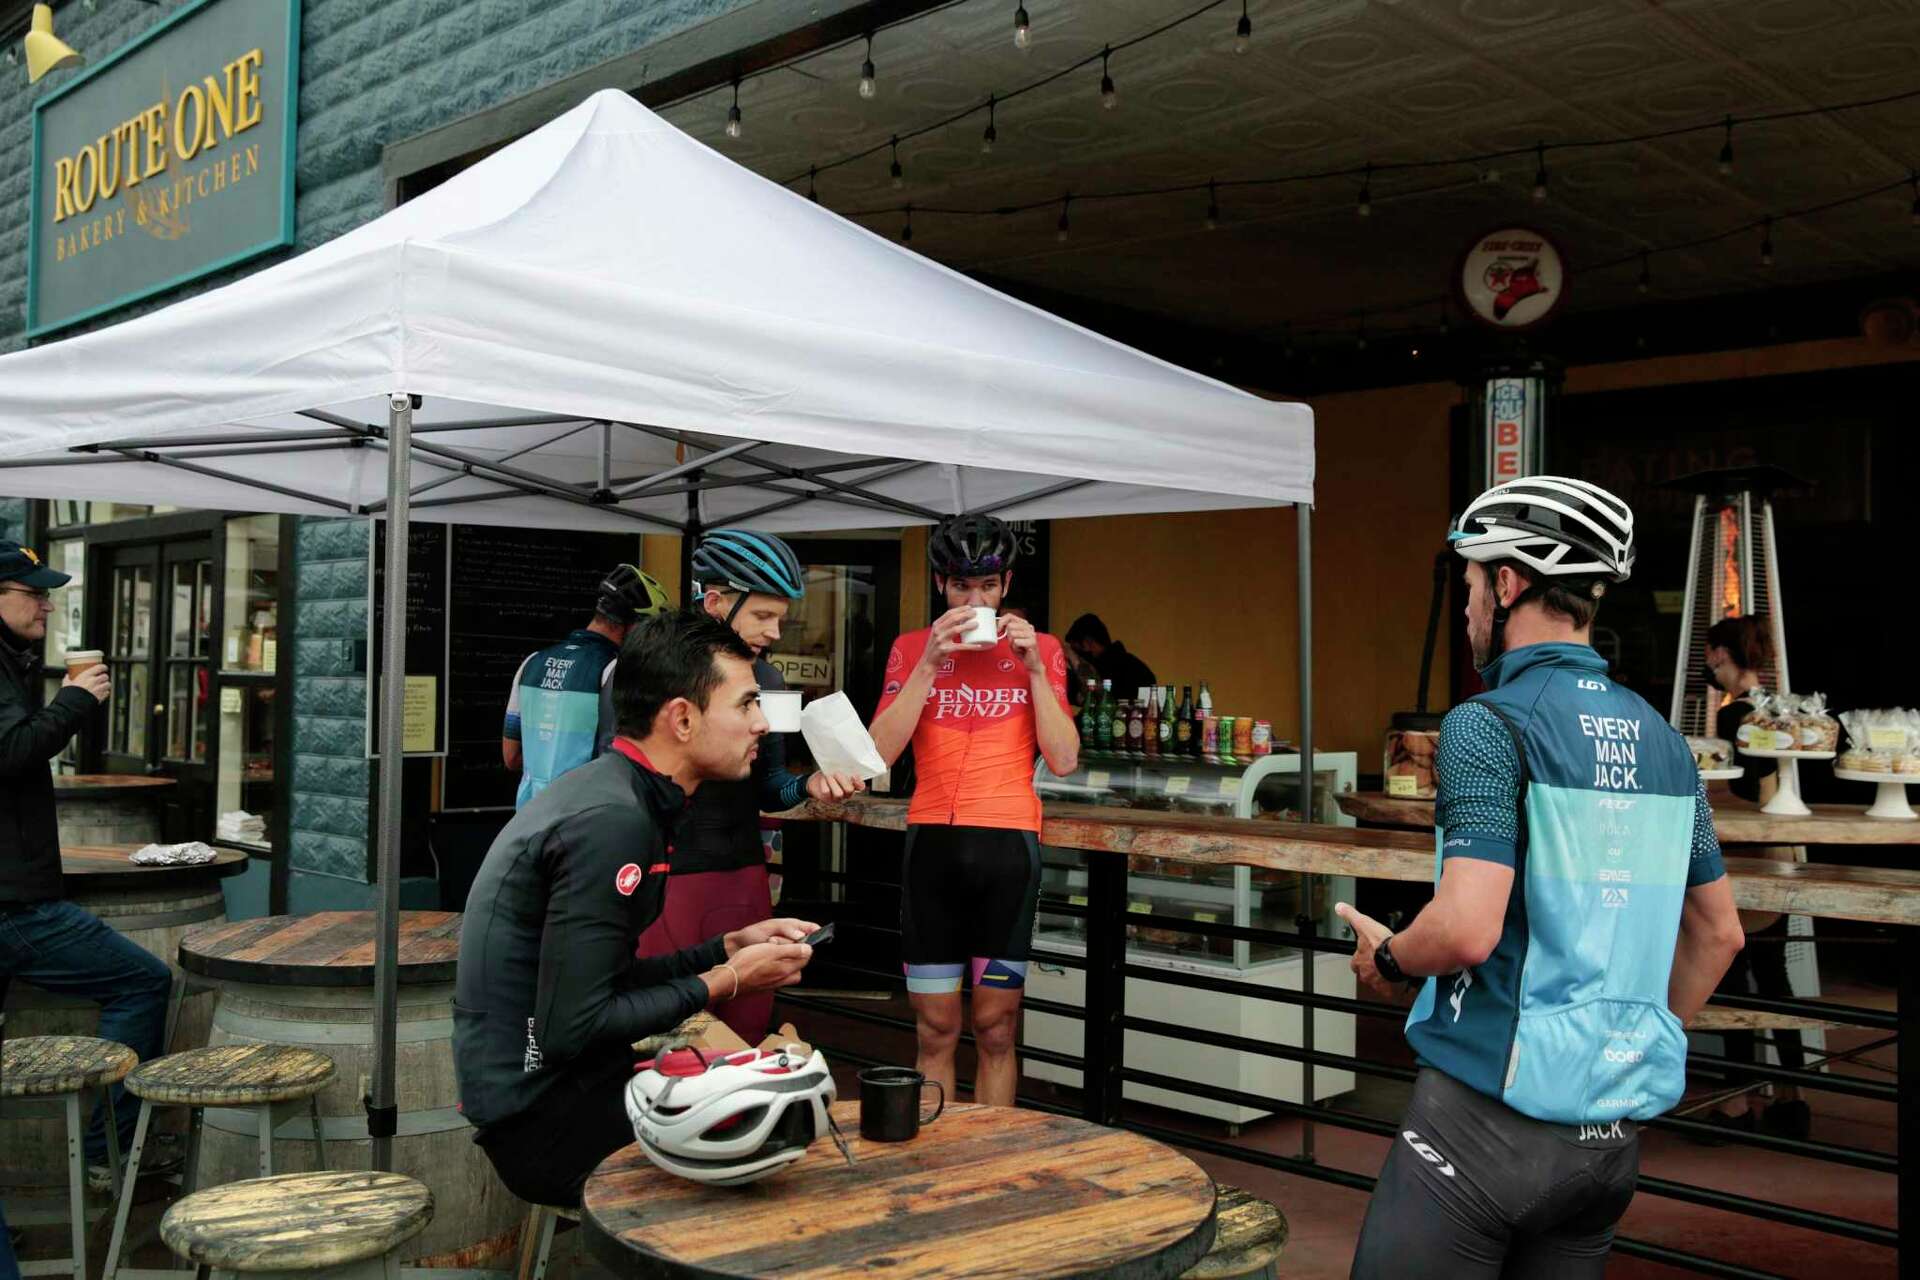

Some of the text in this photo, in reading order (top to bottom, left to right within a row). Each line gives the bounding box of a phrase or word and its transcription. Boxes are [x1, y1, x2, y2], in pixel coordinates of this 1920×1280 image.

[54, 48, 263, 223] ROUTE ONE
[57, 209, 126, 261] BAKERY
[160, 144, 259, 218] KITCHEN
[545, 657, 575, 669] EVERY
[771, 660, 827, 679] OPEN
[546, 668, 567, 679] MAN
[541, 678, 563, 690] JACK
[925, 683, 1029, 705] PENDER
[935, 703, 1011, 720] FUND
[1579, 714, 1640, 741] EVERY
[1594, 739, 1637, 765] MAN
